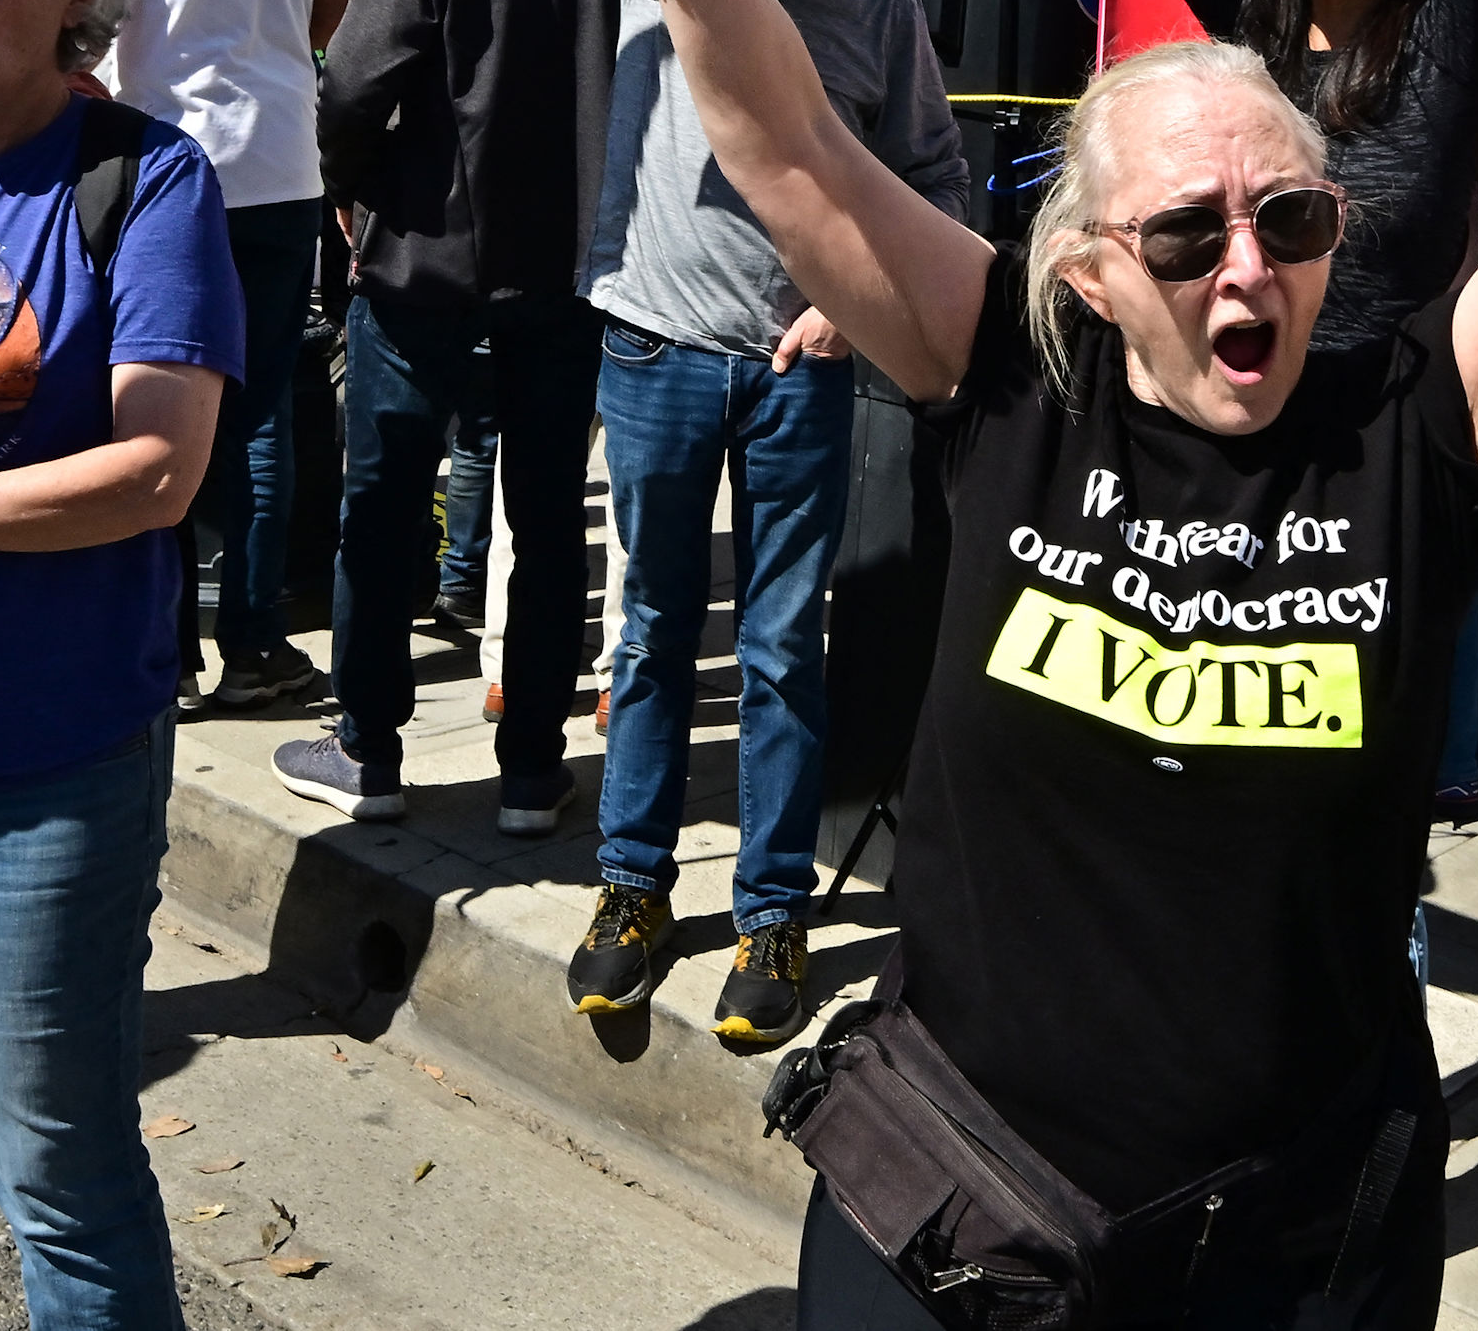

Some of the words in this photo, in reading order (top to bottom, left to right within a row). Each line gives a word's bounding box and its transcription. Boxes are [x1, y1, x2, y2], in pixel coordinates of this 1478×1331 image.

[1008, 525, 1103, 586] our
[1081, 468, 1179, 568] Wth
[1276, 510, 1351, 565] for
[1021, 613, 1073, 680] I
[1097, 626, 1343, 733] VOTE.
